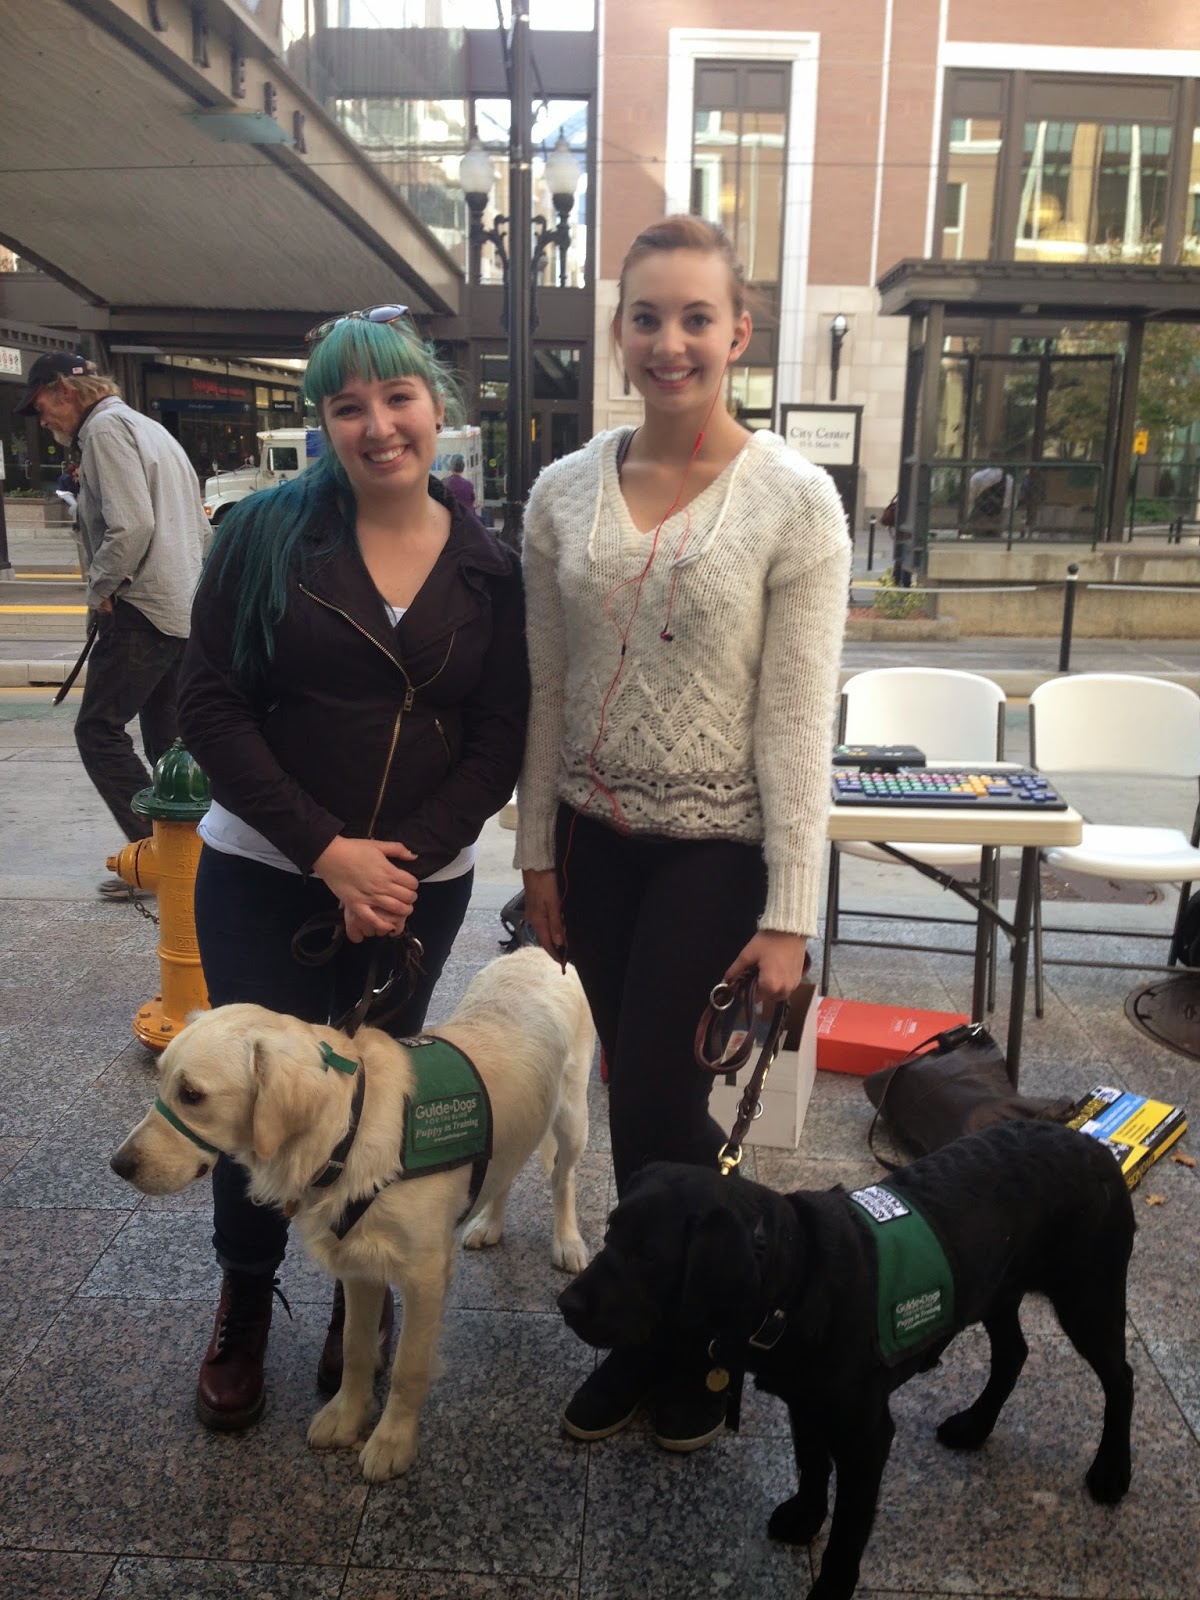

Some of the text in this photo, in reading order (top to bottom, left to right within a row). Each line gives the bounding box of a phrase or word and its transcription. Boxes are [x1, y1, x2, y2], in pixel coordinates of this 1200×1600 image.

[790, 426, 851, 440] City Center
[415, 1098, 477, 1119] Guide Dogs
[416, 1127, 443, 1139] Puppy
[453, 1119, 479, 1130] Training
